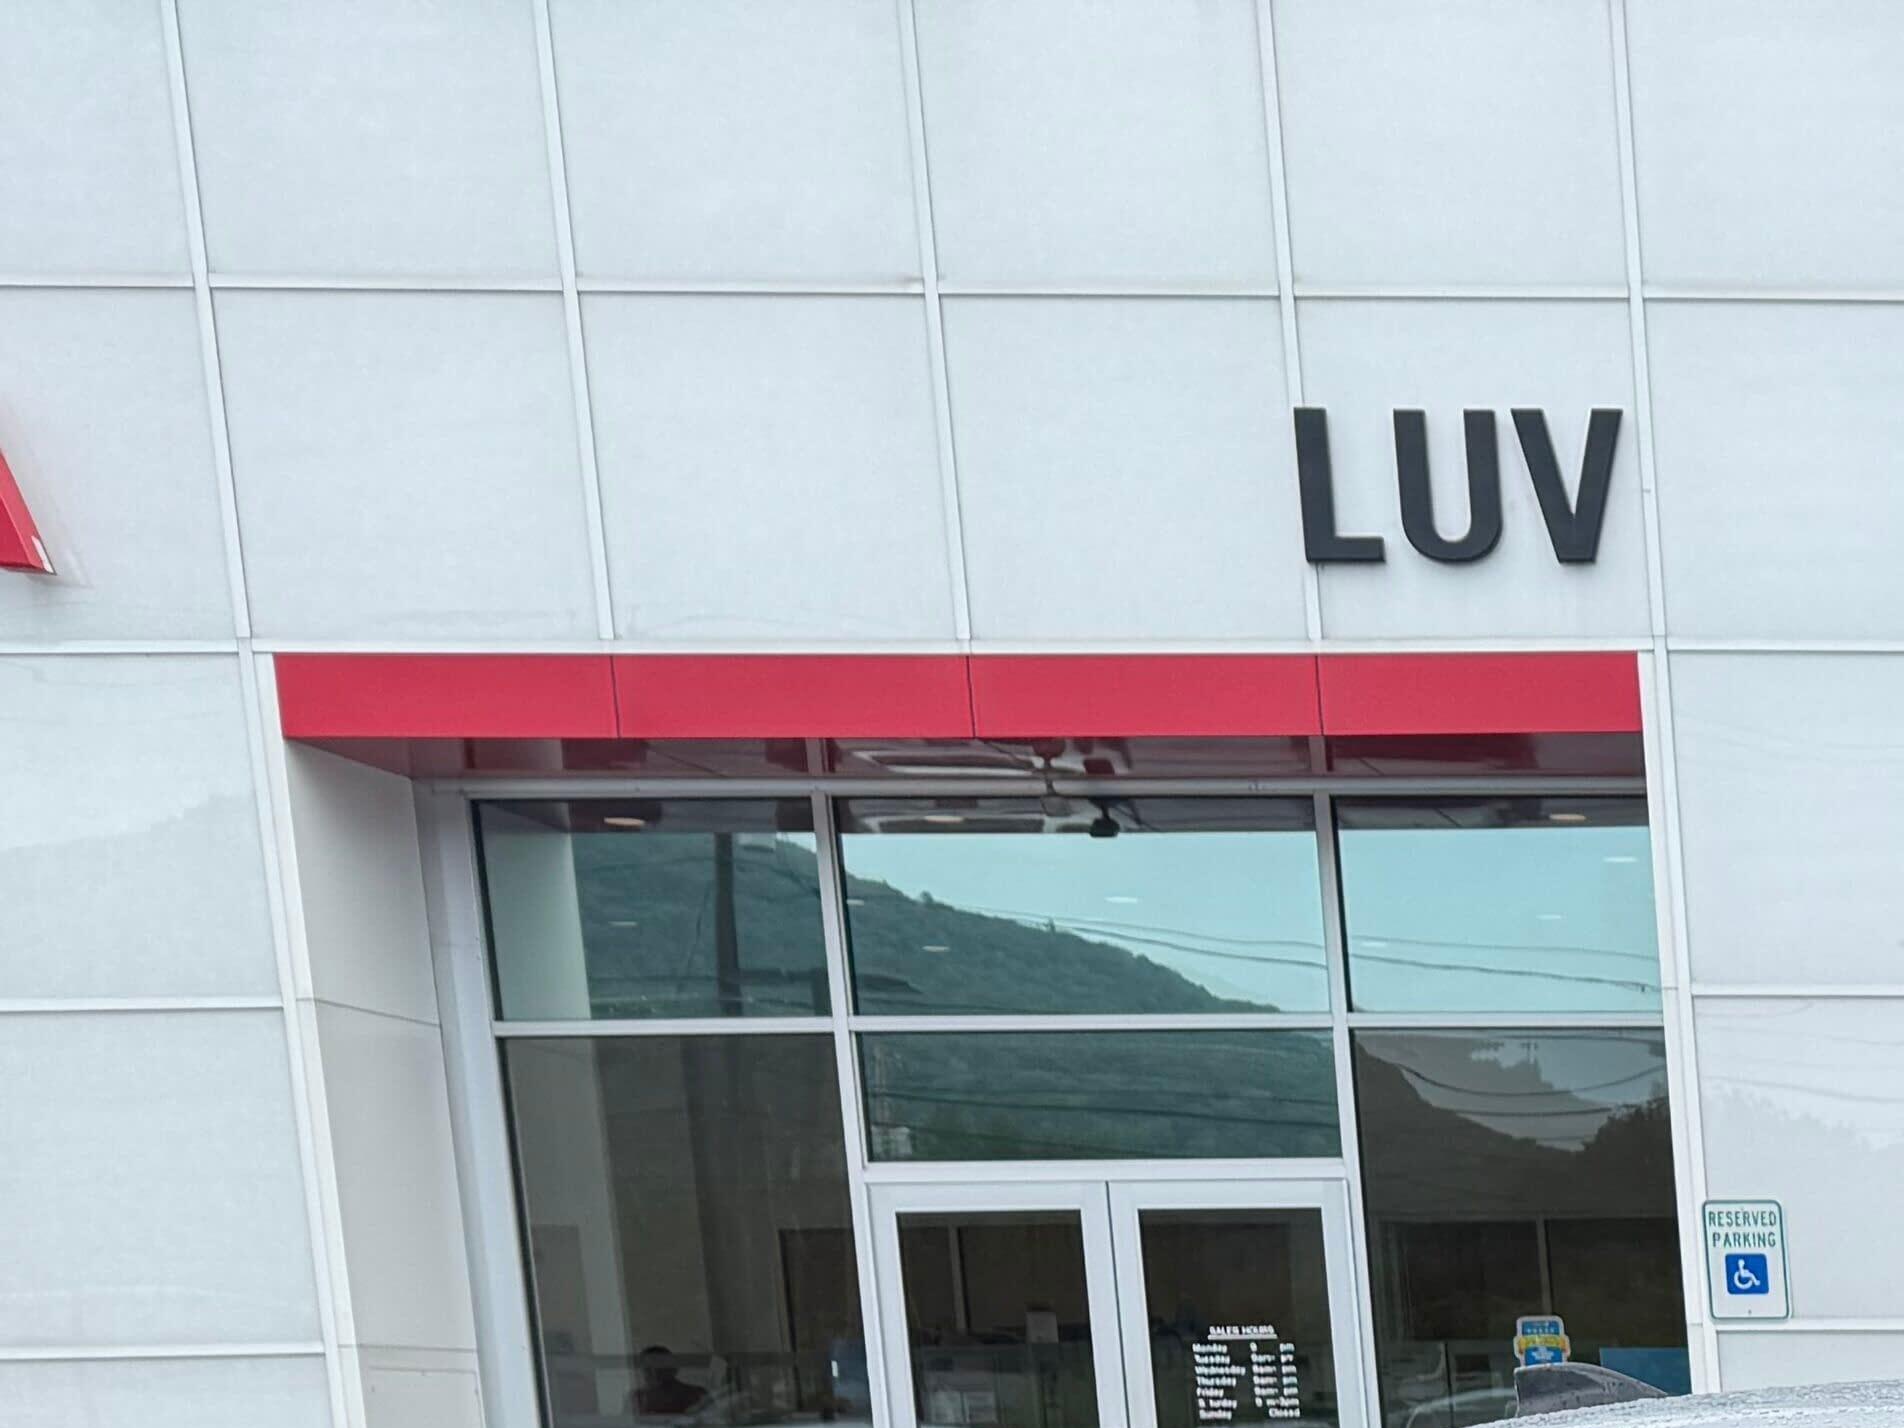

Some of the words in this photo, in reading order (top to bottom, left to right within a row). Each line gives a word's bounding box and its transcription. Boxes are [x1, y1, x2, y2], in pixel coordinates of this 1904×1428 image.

[1293, 406, 1623, 563] LUV
[1708, 1210, 1777, 1227] RESERVED
[1712, 1231, 1777, 1248] PARKING
